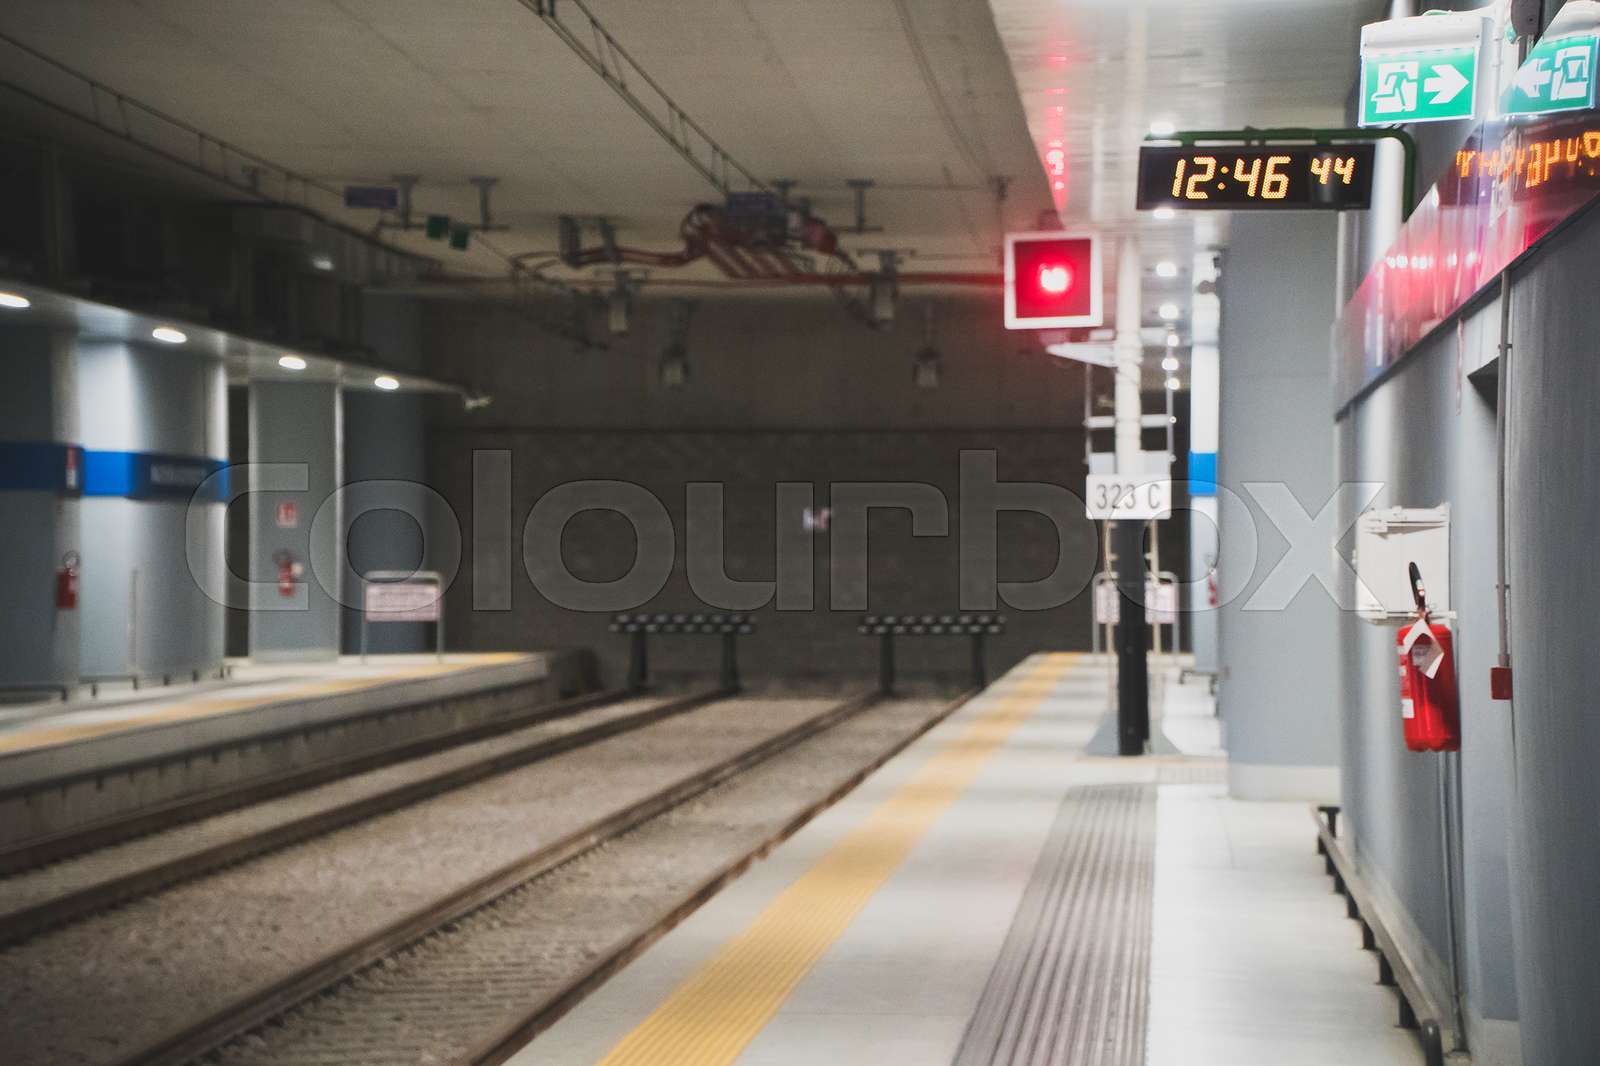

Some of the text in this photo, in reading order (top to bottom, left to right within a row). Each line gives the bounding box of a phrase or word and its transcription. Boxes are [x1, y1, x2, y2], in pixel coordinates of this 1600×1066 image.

[1171, 155, 1356, 200] 12:46 44
[1096, 483, 1161, 511] 323 C
